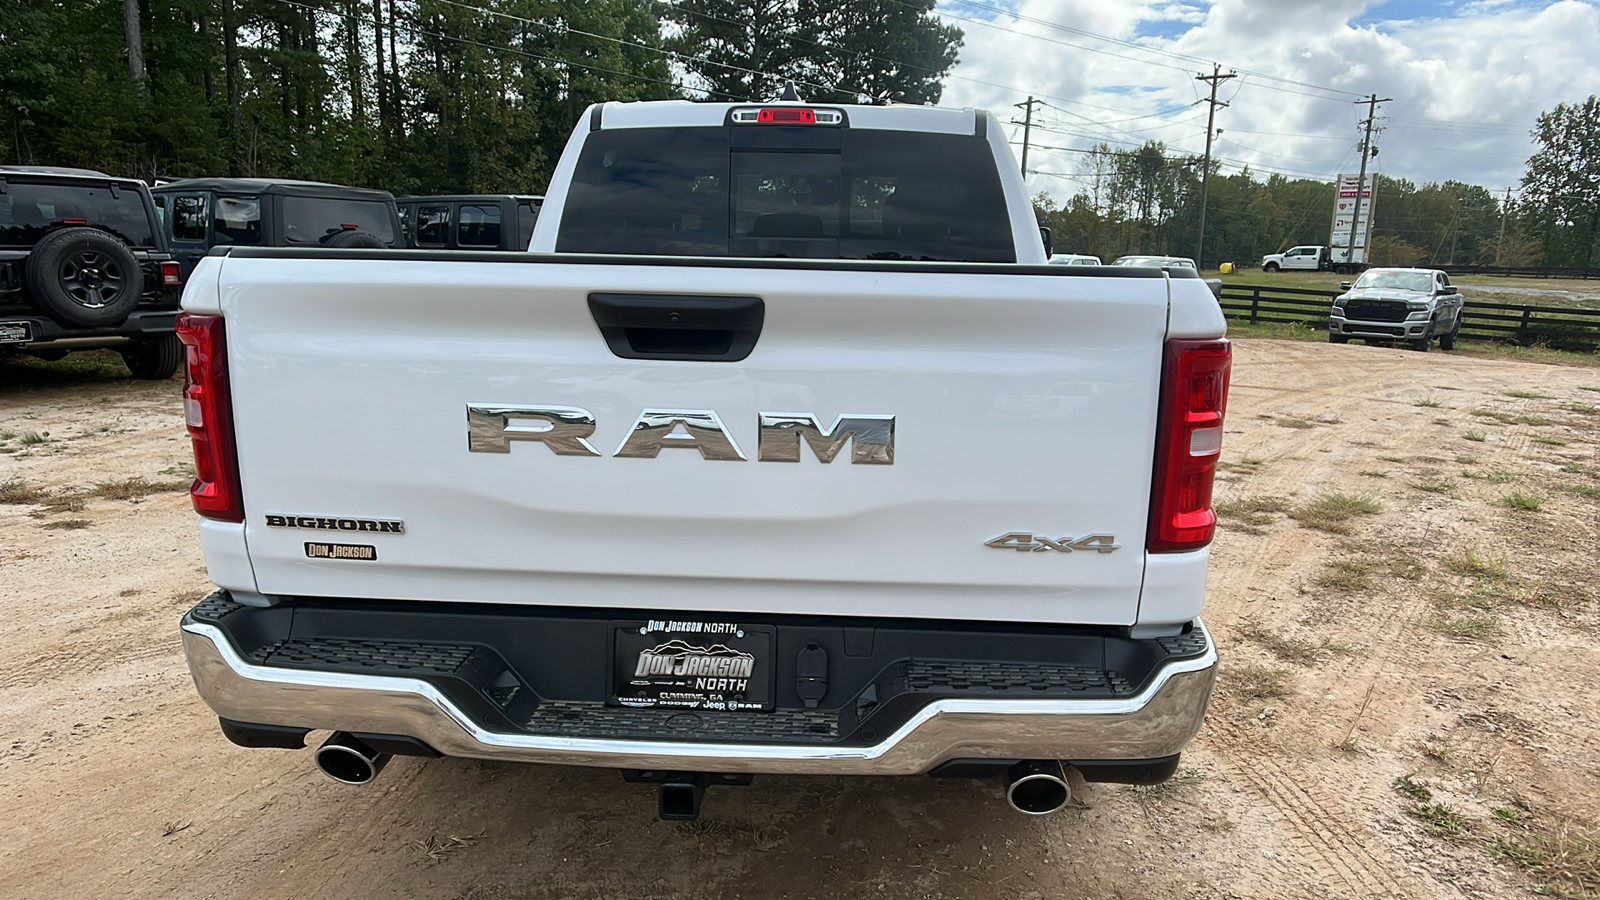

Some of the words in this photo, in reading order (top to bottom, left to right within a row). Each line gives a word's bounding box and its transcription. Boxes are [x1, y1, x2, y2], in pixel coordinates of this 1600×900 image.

[466, 402, 896, 465] RAM
[265, 513, 405, 535] BIGHORN
[984, 531, 1121, 554] 4x4
[308, 543, 329, 557] DON
[329, 545, 373, 559] JACKSON
[647, 619, 665, 632] DON
[665, 620, 703, 634] JACKSON
[703, 622, 737, 635] NORTH
[635, 654, 674, 677] DON
[674, 655, 755, 678] JACKSON
[695, 677, 748, 692] NORTH
[709, 693, 724, 701] GA
[702, 700, 726, 711] Jeep
